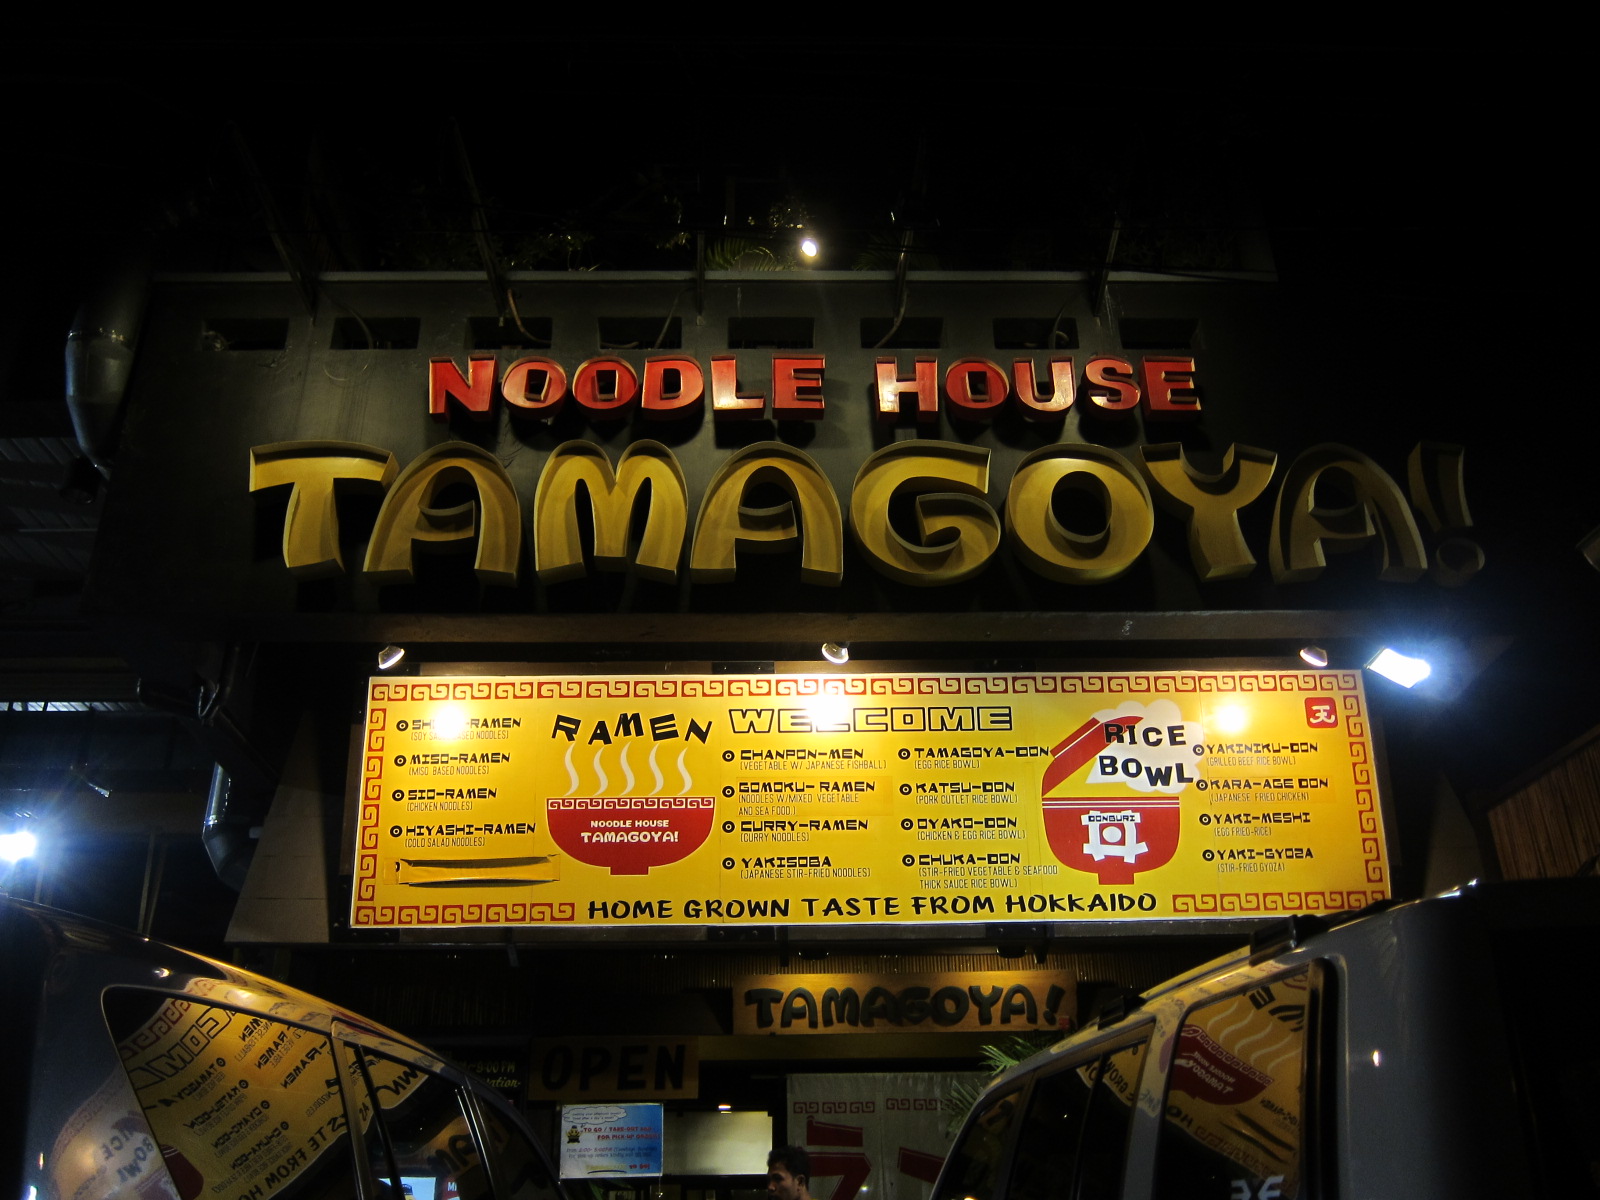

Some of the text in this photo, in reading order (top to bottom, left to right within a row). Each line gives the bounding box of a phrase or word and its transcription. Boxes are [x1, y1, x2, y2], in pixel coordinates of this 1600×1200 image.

[428, 355, 1202, 422] NOODLE HOUSE
[249, 438, 1485, 588] TAMAGOYA!
[552, 713, 713, 745] RAMEN
[476, 730, 509, 740] NOODLES)
[1104, 723, 1187, 747] RICE
[914, 746, 1049, 758] TAMAGOYA-DON
[1207, 743, 1318, 754] YAKINIKU-DON
[410, 753, 511, 765] MISO-RAMEN
[741, 749, 864, 760] CHANPON-MEN
[740, 760, 887, 770] (VEGETABLE W/ JAPANESE FISHBALL)
[915, 759, 980, 769] (EGG RICE BOWL)
[1207, 756, 1296, 767] (GRILLED BEEF RICE BOWL)
[409, 765, 490, 776] (MISO BASED NOODLES)
[1098, 755, 1194, 787] BOWL
[739, 781, 875, 792] GOMOKU- RAMEN
[916, 782, 1015, 793] KATSU-DON
[1210, 778, 1328, 790] KARA-AGE DON
[408, 788, 497, 800] SIO-RAMEN
[739, 793, 859, 803] (NOODLES W/MIXED VEGETABLE
[916, 794, 1018, 804] (PORK CUTLET RICE BOWL)
[1210, 792, 1309, 802] (JAPANESE FRIED CHICKEN)
[407, 801, 473, 812] (CHICKEN NOODLES)
[739, 806, 752, 815] AND
[755, 806, 769, 815] SEA
[917, 817, 1017, 829] OYAKO-DON
[1213, 812, 1311, 824] YAKI-MESHI
[406, 823, 536, 836] HIYASHI-RAMEN
[591, 820, 669, 828] NOODLE HOUSE
[741, 820, 868, 832] CURRY-RAMEN
[581, 831, 679, 843] TAMAGOYA!
[741, 832, 809, 842] (CURRY NOODLES)
[918, 830, 1026, 840] (CHICKEN & EGG RICE BOWL)
[1214, 827, 1272, 836] (EGG FRIED-RICE)
[405, 837, 485, 848] (COLD SALAD NOODLES)
[919, 853, 1020, 865] CHUKA-DON
[1217, 848, 1314, 860] YAKI-GYOZA
[742, 856, 831, 868] YAKISOBA
[741, 868, 871, 879] (JAPANESE STIR-FRIED NOODLES)
[919, 865, 1058, 877] (STIR-FRIED VEGETABLE & SEAFOOD
[1217, 863, 1285, 873] (STIR-FRIED GYOZA)
[920, 879, 1018, 889] THICK SAUCE RICE BOWL)
[588, 893, 1157, 919] HOME GROWN TASTE FROM HOKKAIDO
[745, 983, 1065, 1028] TAMAGOYA!
[541, 1044, 686, 1092] OPEN
